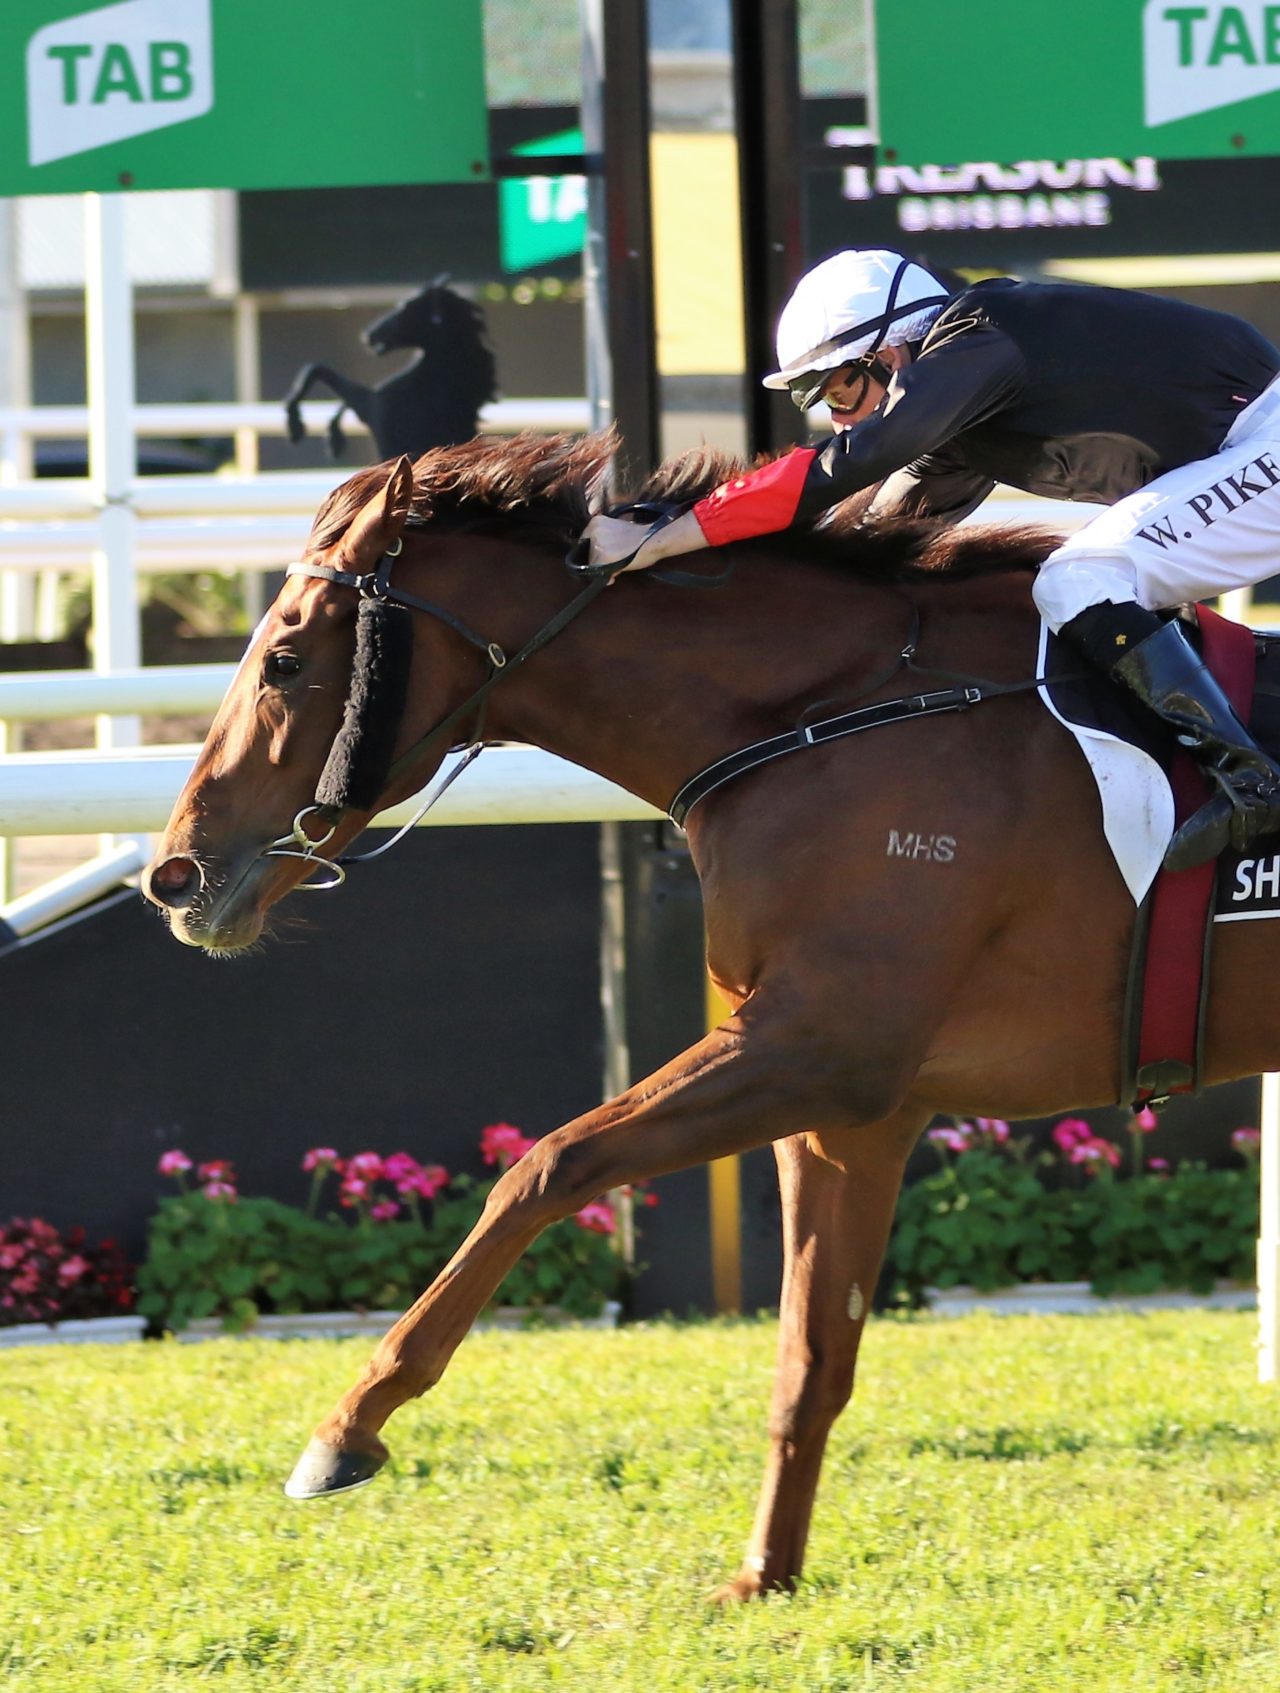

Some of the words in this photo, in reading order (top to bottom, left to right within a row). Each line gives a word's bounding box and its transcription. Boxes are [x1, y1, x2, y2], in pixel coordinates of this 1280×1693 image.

[47, 42, 193, 104] TAB
[1136, 515, 1192, 551] W.
[887, 829, 957, 862] MHS
